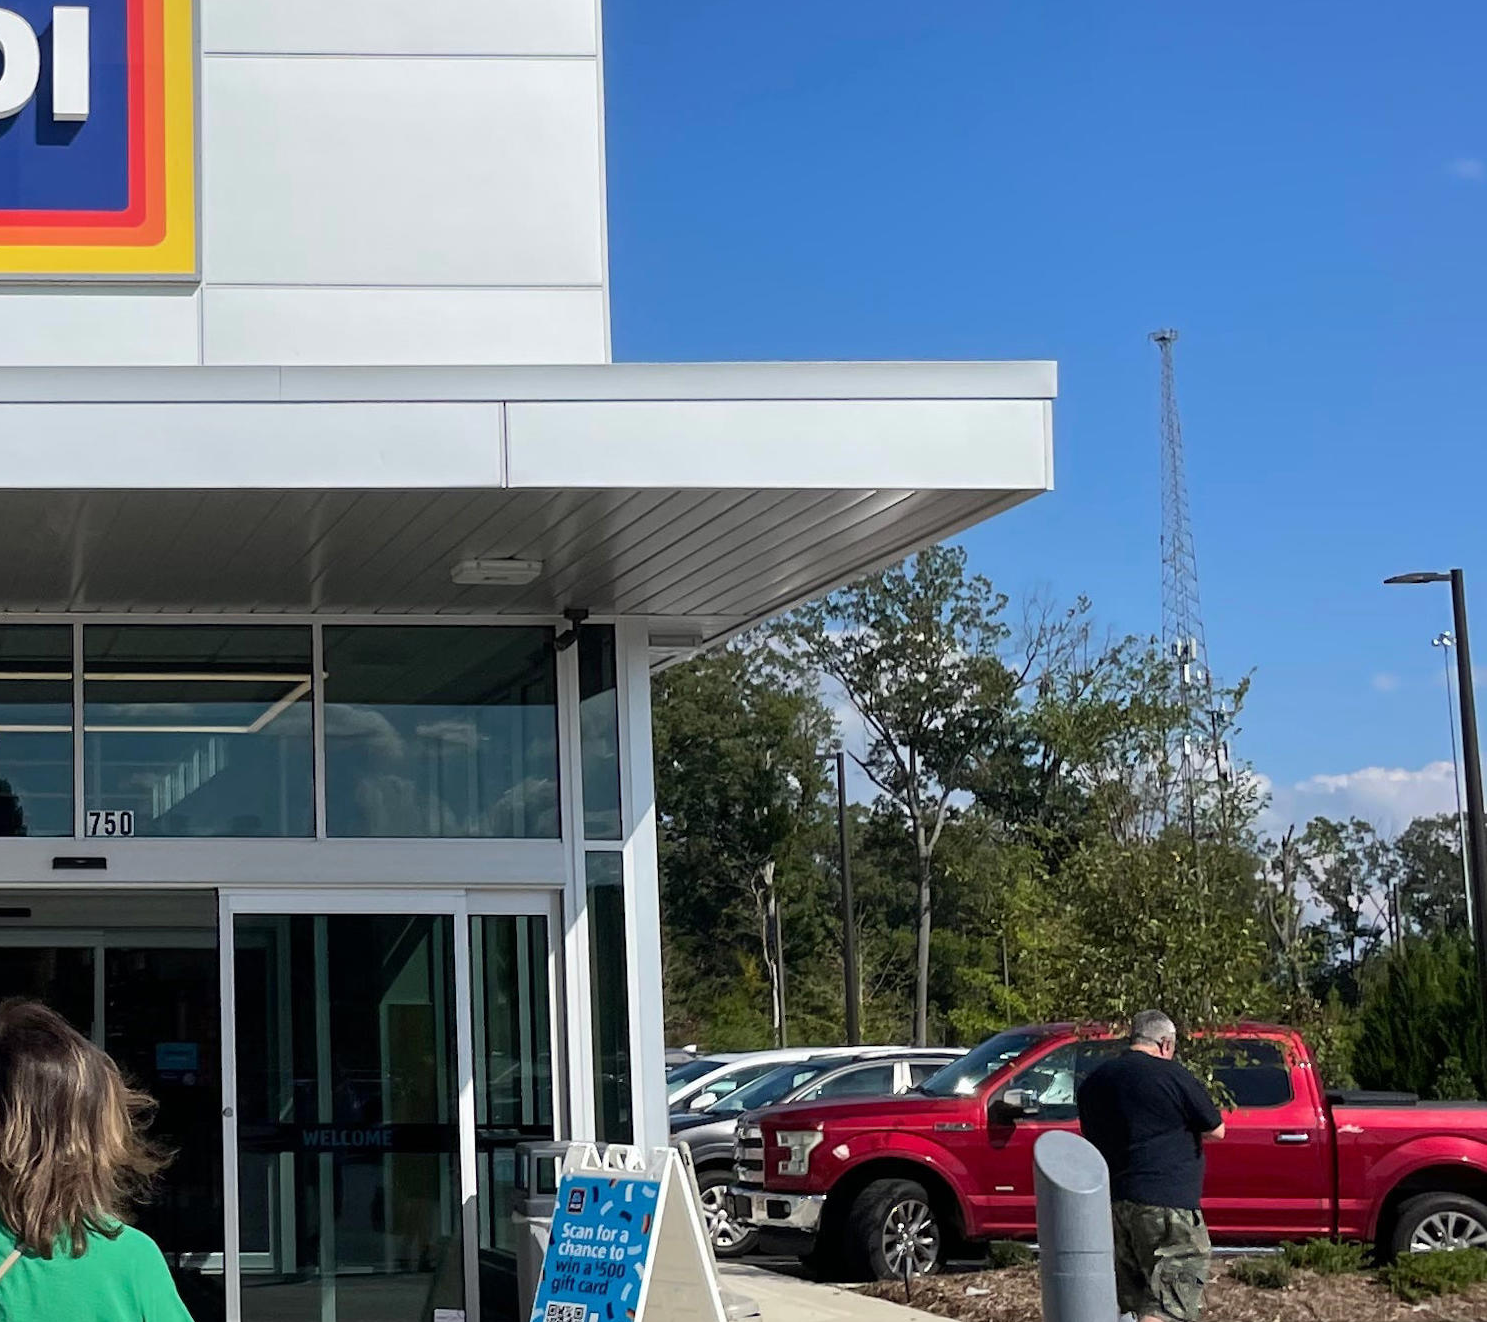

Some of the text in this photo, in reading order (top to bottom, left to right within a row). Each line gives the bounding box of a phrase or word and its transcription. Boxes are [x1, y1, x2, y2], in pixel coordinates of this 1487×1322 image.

[89, 811, 132, 835] 750
[302, 1129, 393, 1146] WELCOME
[561, 1222, 630, 1243] Scan for a
[558, 1239, 625, 1261] chance to
[555, 1256, 625, 1278] win a $500
[551, 1274, 609, 1295] gift card
